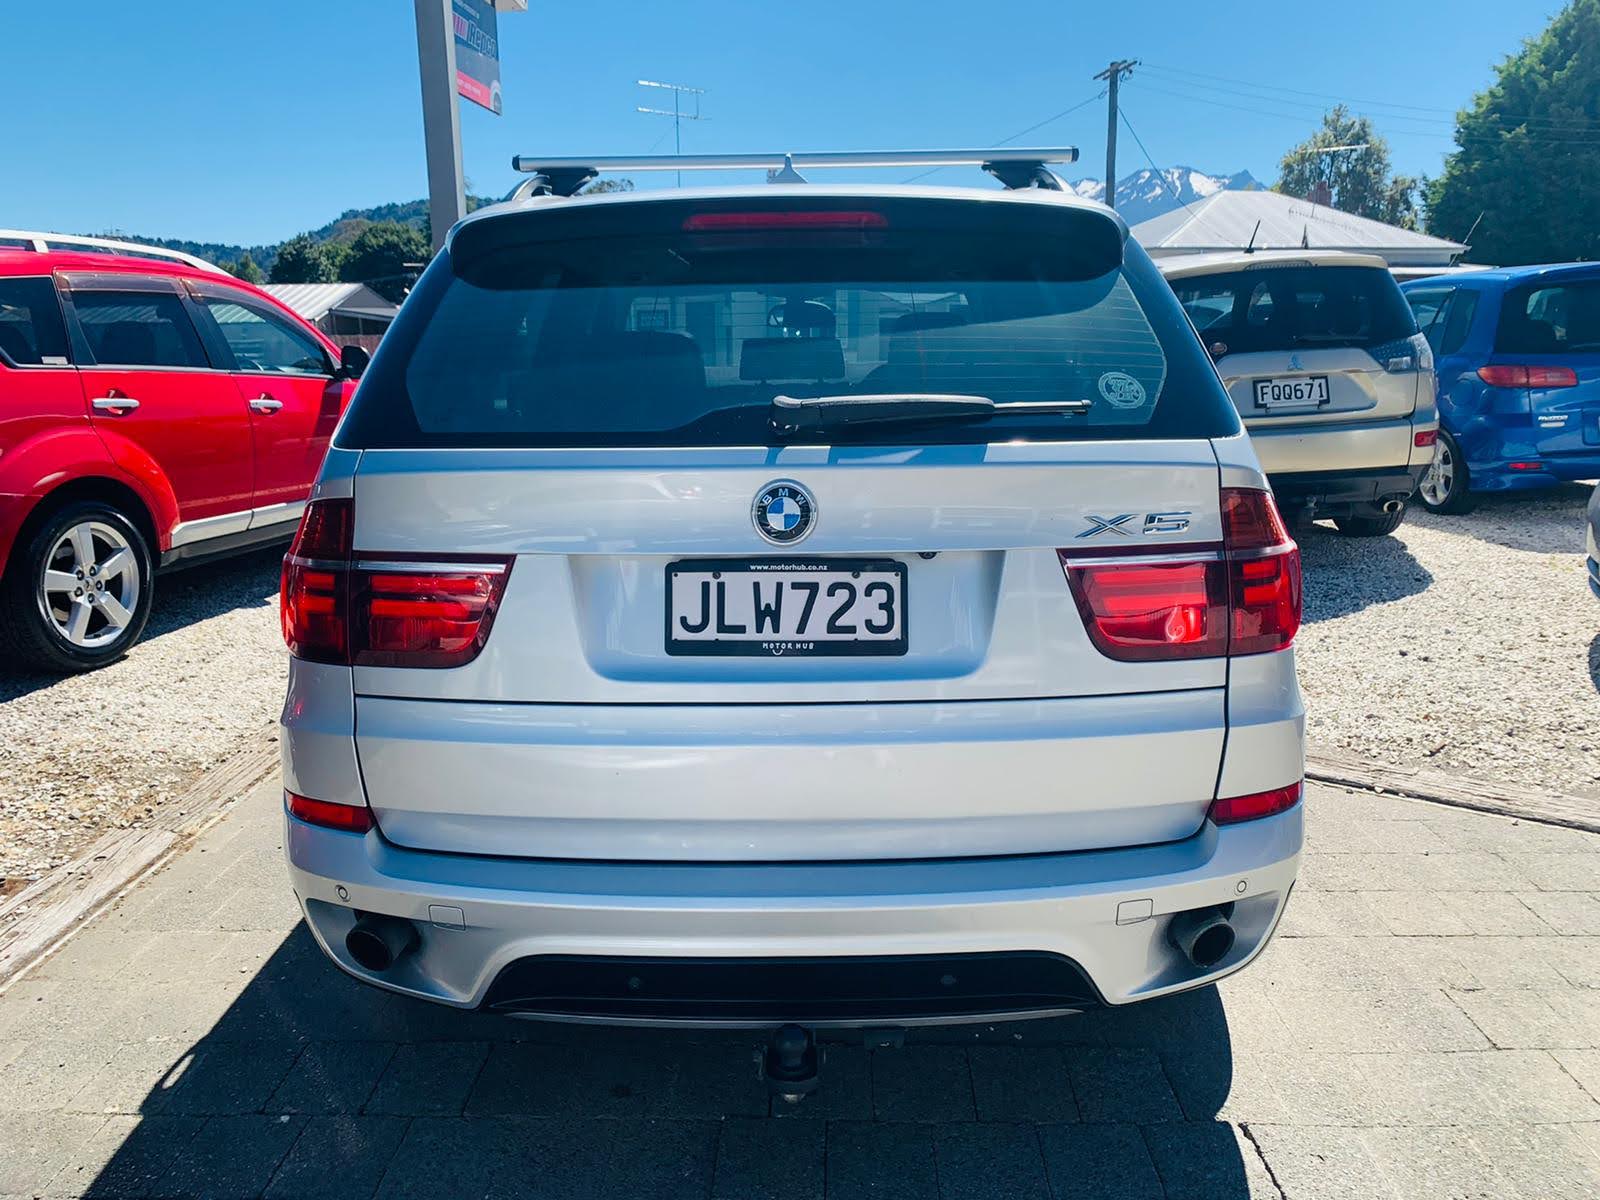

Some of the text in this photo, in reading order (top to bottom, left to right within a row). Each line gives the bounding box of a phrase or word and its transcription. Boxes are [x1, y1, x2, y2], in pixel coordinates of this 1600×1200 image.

[1260, 382, 1325, 402] FQQ671
[762, 487, 806, 506] BMW
[1074, 511, 1192, 538] X5
[749, 563, 828, 571] www.motorhub.co.nz
[679, 581, 896, 634] JLW723
[762, 642, 815, 650] MOTOR HUB
